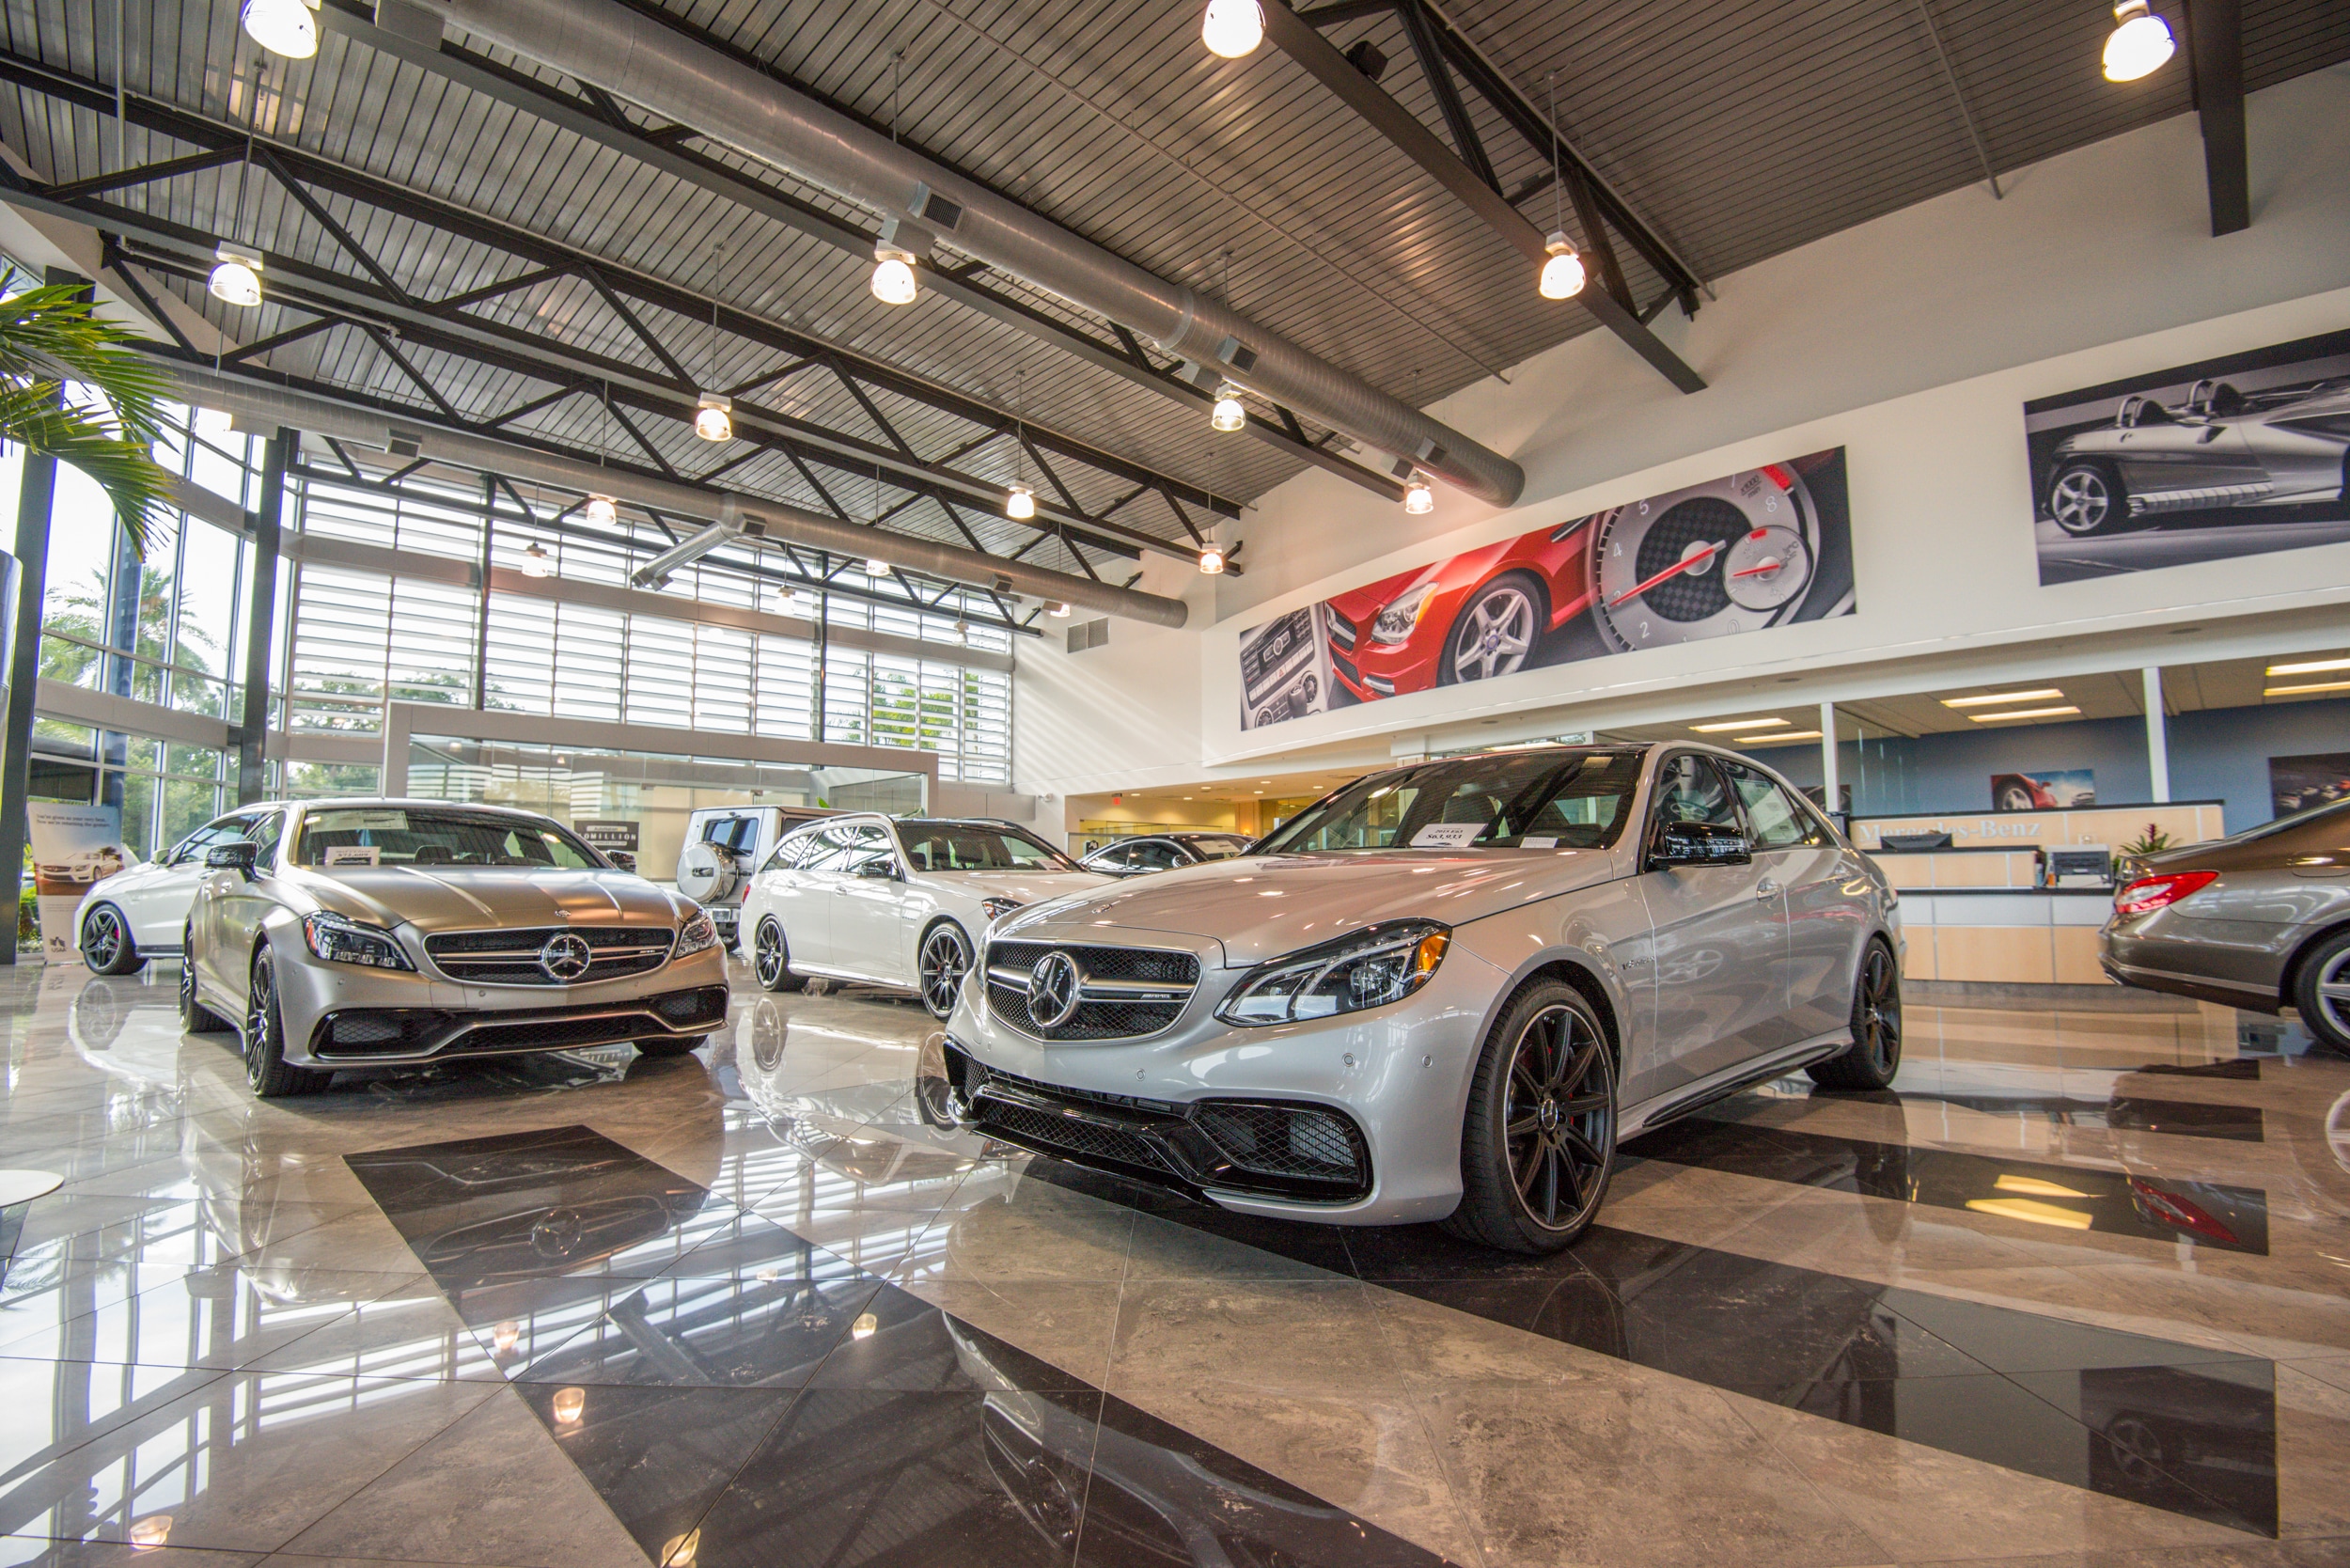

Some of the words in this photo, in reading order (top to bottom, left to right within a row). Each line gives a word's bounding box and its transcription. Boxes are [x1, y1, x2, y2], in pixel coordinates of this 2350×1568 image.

[1639, 499, 1649, 515] 5
[1765, 495, 1777, 512] 8
[1613, 542, 1622, 557] 4
[1640, 621, 1650, 638] 2
[1728, 619, 1740, 635] 0
[1859, 820, 2041, 841] Mercedes-Benz
